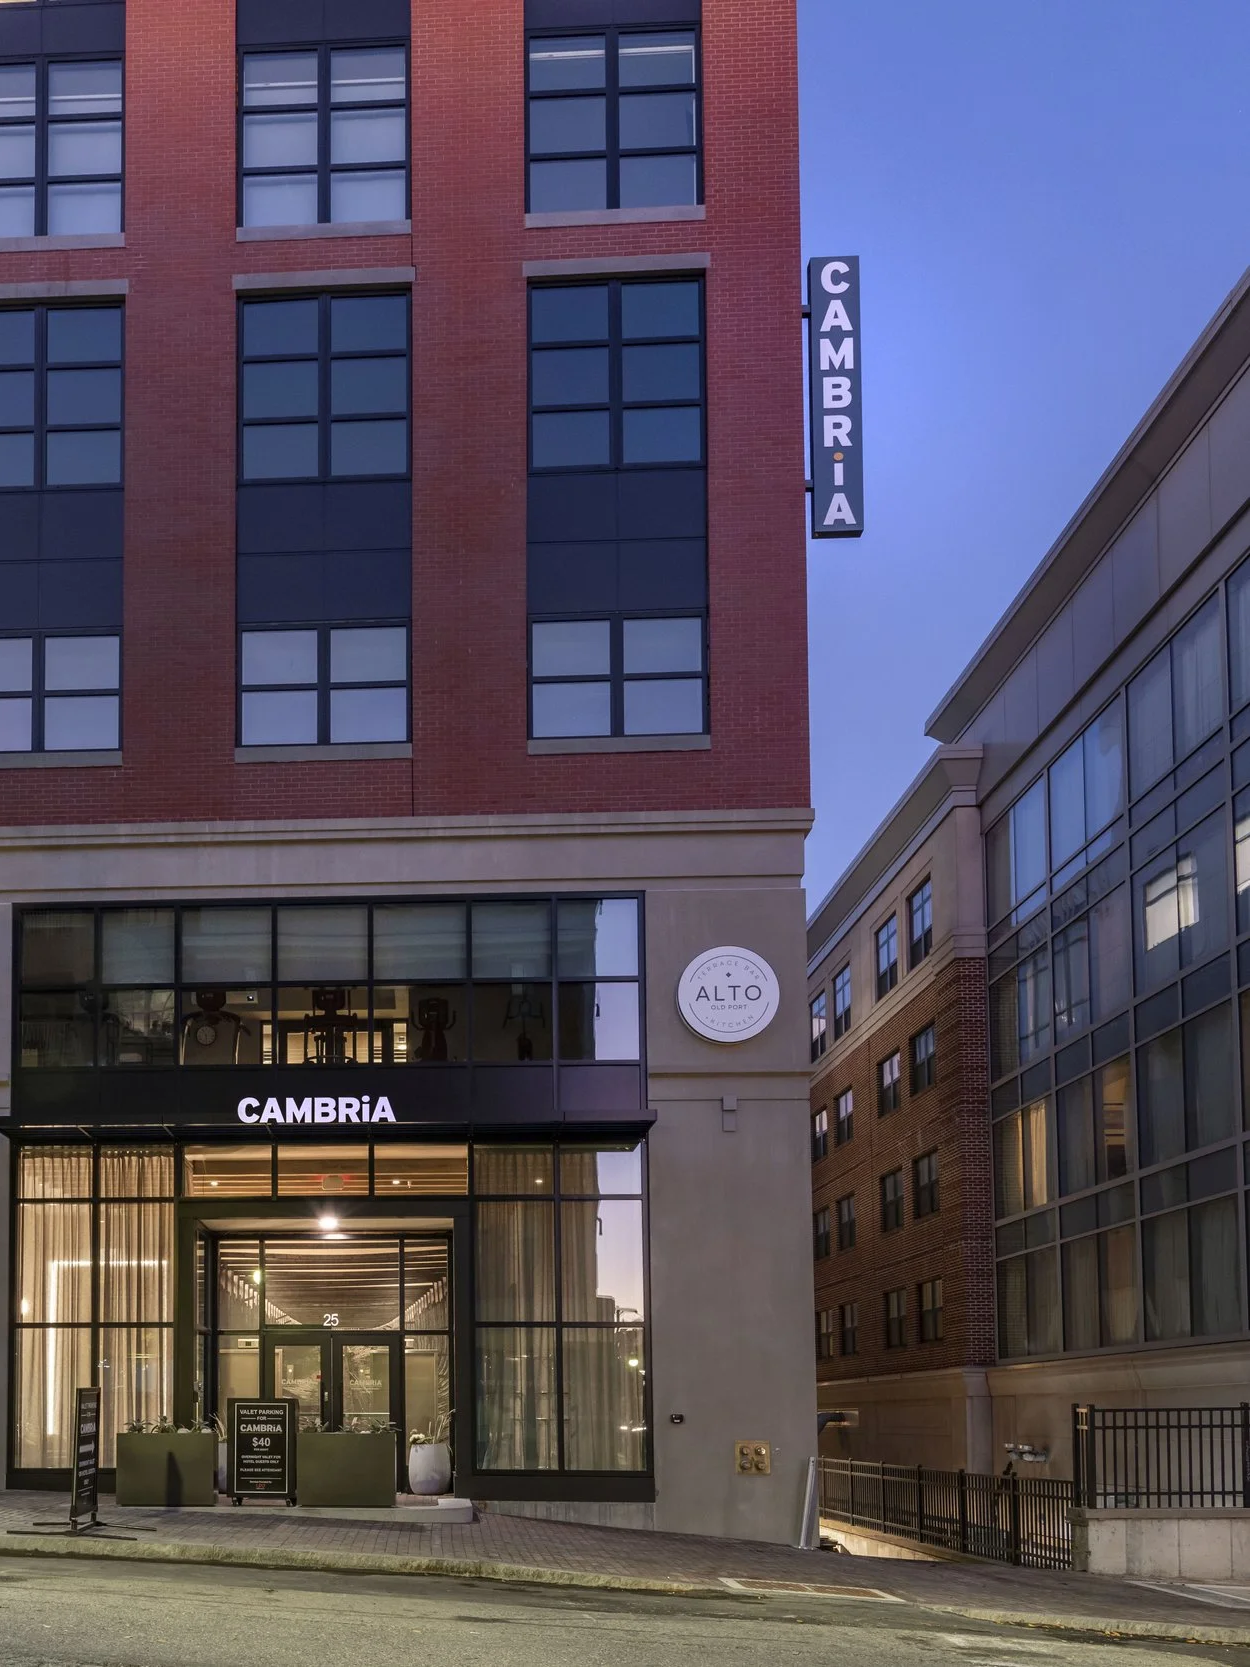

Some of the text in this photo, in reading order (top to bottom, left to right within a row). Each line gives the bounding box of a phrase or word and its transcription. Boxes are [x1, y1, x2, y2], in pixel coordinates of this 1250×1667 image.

[698, 960, 760, 980] TERRACE BAR
[695, 984, 762, 1002] ALTO
[237, 1095, 397, 1124] CAMBRiA
[323, 1313, 340, 1327] 25
[252, 1436, 271, 1447] $40
